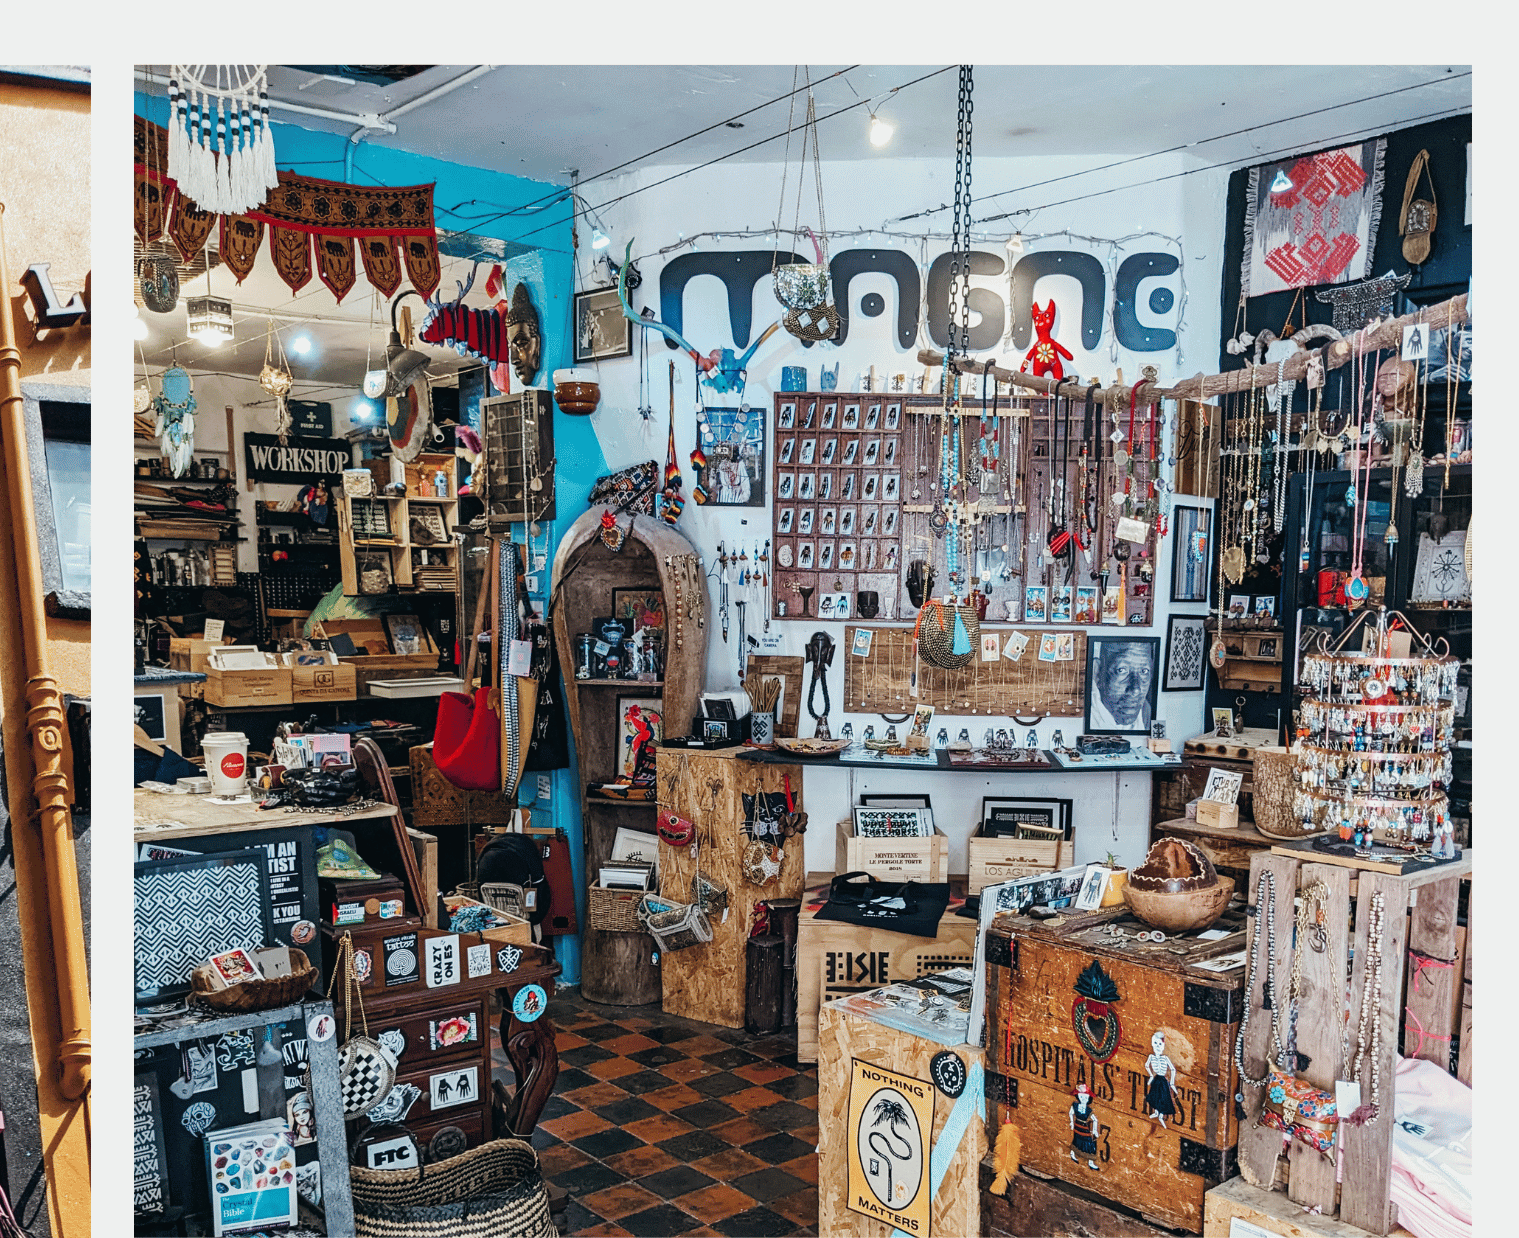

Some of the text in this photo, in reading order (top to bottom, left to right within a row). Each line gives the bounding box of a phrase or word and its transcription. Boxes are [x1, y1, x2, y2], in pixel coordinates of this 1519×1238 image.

[249, 444, 350, 475] WORKSHOP
[277, 841, 297, 857] AN
[984, 866, 1003, 877] LOS
[282, 904, 301, 917] YOU
[433, 946, 443, 985] CRAZY
[862, 1069, 924, 1098] NOTHING
[374, 1145, 410, 1167] FTC
[223, 1207, 245, 1218] Bible
[858, 1196, 919, 1231] MATTERS
